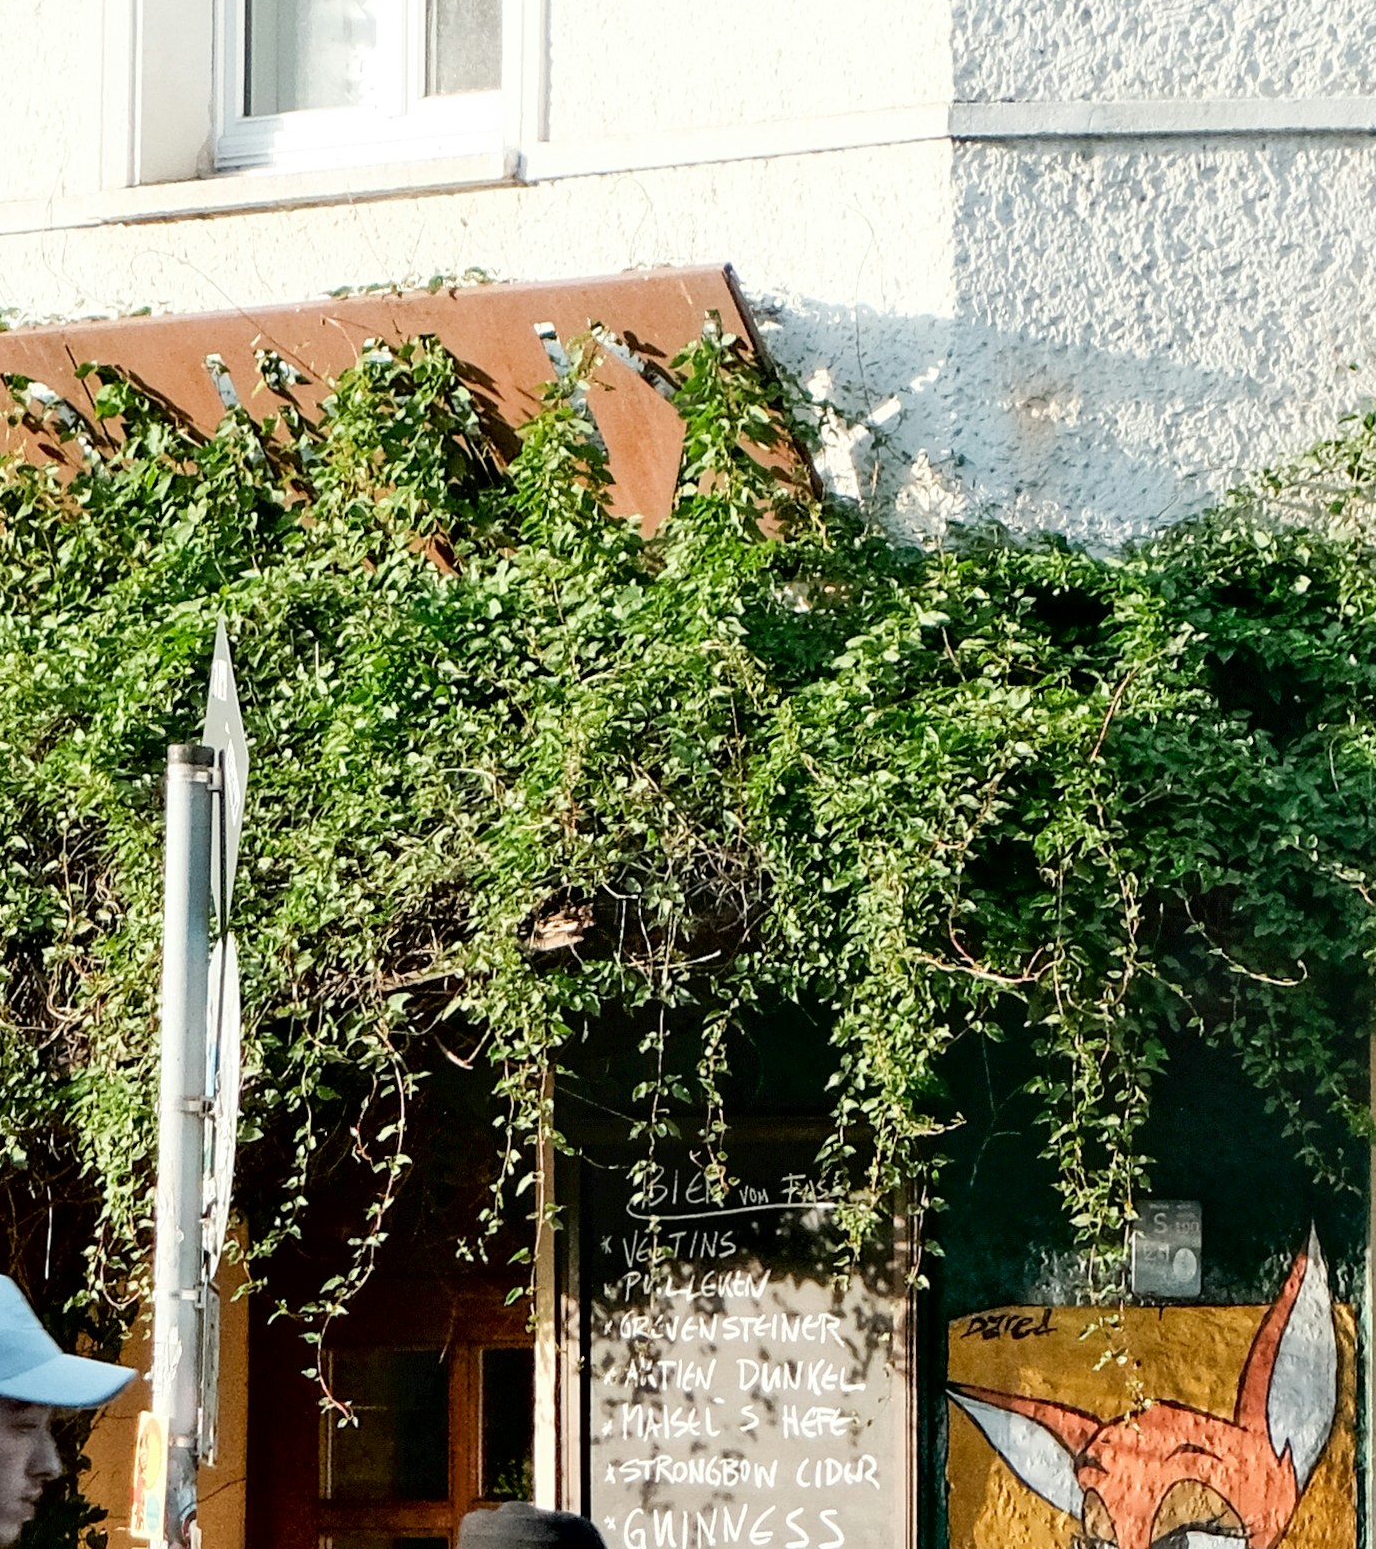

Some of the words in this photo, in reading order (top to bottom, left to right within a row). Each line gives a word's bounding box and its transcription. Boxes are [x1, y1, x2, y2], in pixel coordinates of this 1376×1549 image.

[738, 1357, 866, 1393] DUNKEL
[781, 1406, 848, 1437] HEFE
[619, 1457, 776, 1487] STRONGBOW
